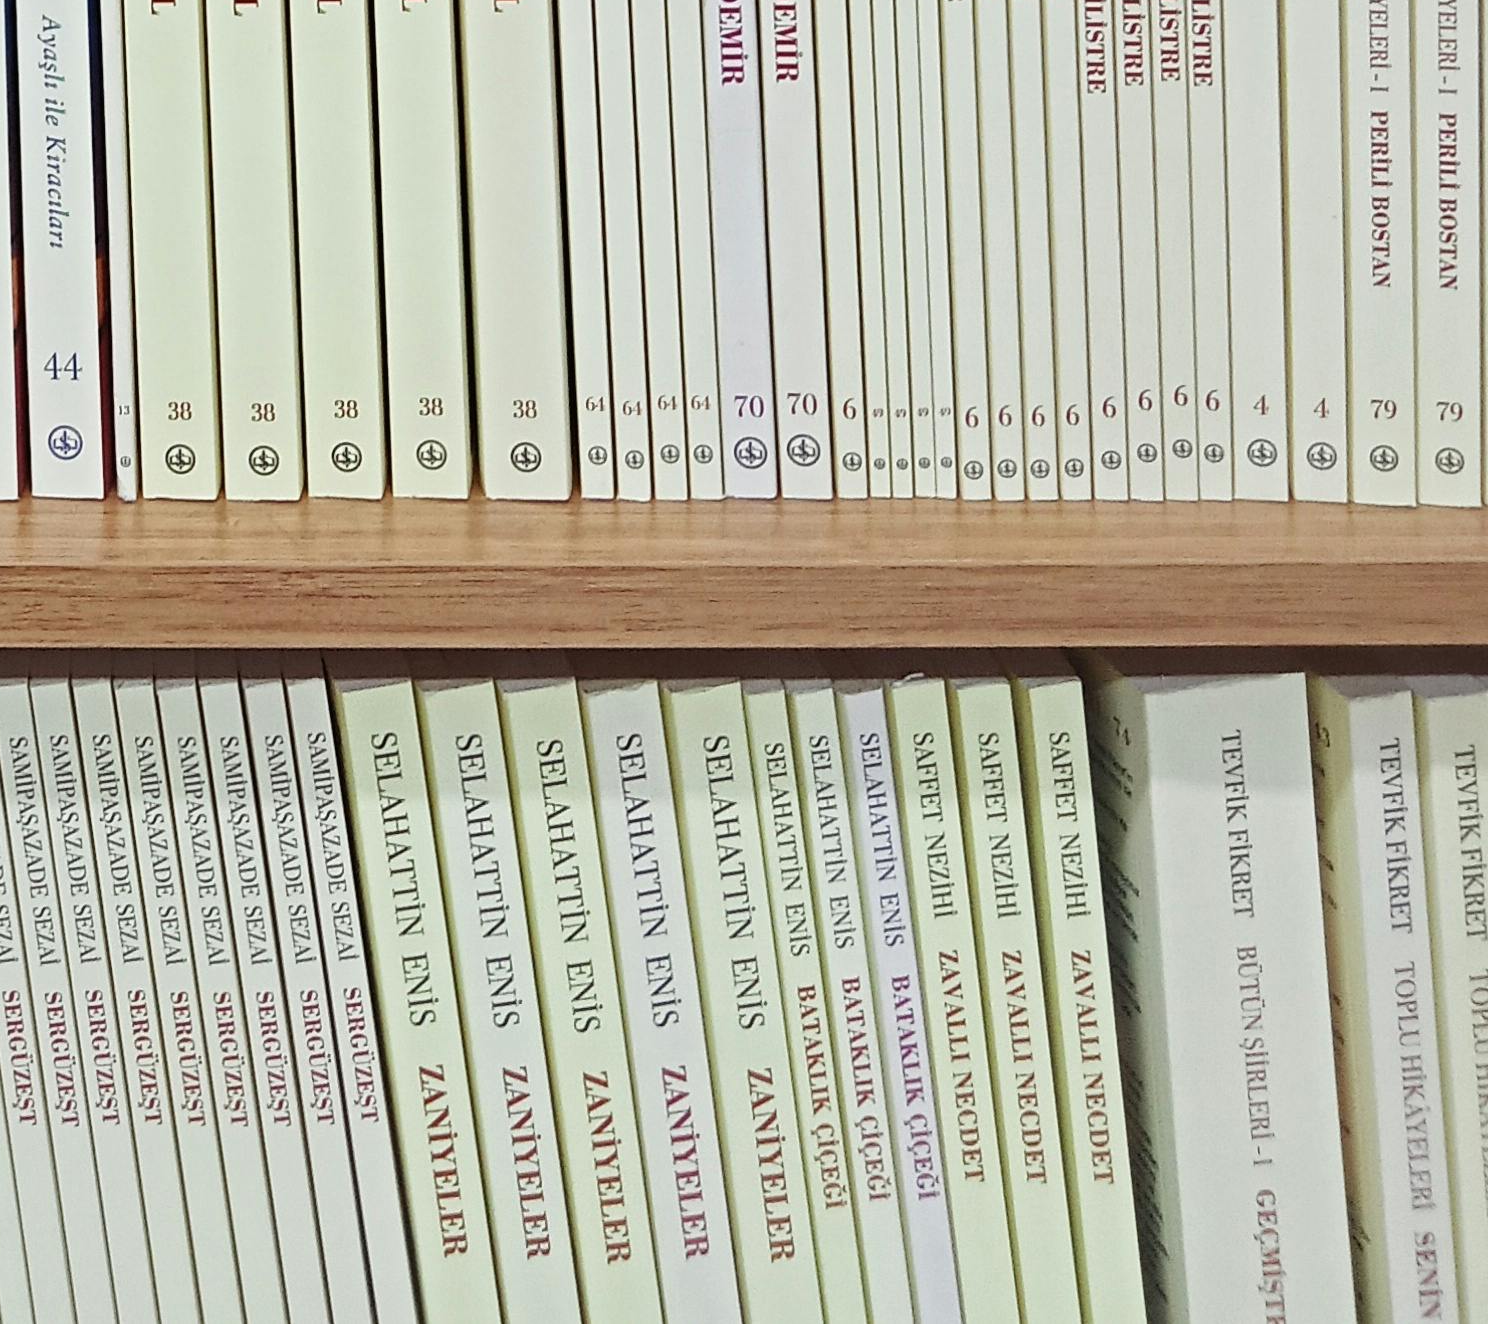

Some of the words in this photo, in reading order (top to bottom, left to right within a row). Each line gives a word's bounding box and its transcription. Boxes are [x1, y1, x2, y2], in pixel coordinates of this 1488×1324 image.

[1369, 110, 1394, 189] PERİLİ
[333, 399, 359, 420] 38
[1173, 384, 1189, 407] 6
[1369, 398, 1398, 420] 79
[1048, 731, 1079, 824] SAFFET
[1220, 728, 1250, 824] TEVFİK
[370, 731, 427, 937] SELAHATTİN
[1058, 831, 1092, 920] NEZİHİ
[1227, 829, 1255, 919] FİKRET
[400, 951, 440, 1027] ENİS
[1070, 949, 1102, 1065] ZAVALLI
[1236, 945, 1266, 1031] BÜTÜN
[342, 986, 380, 1124] SERGÜZEŞT
[1238, 1036, 1276, 1141] ŞİİRLERİ
[418, 1063, 469, 1259] ZANİYELER
[1082, 1071, 1115, 1186] NECDET
